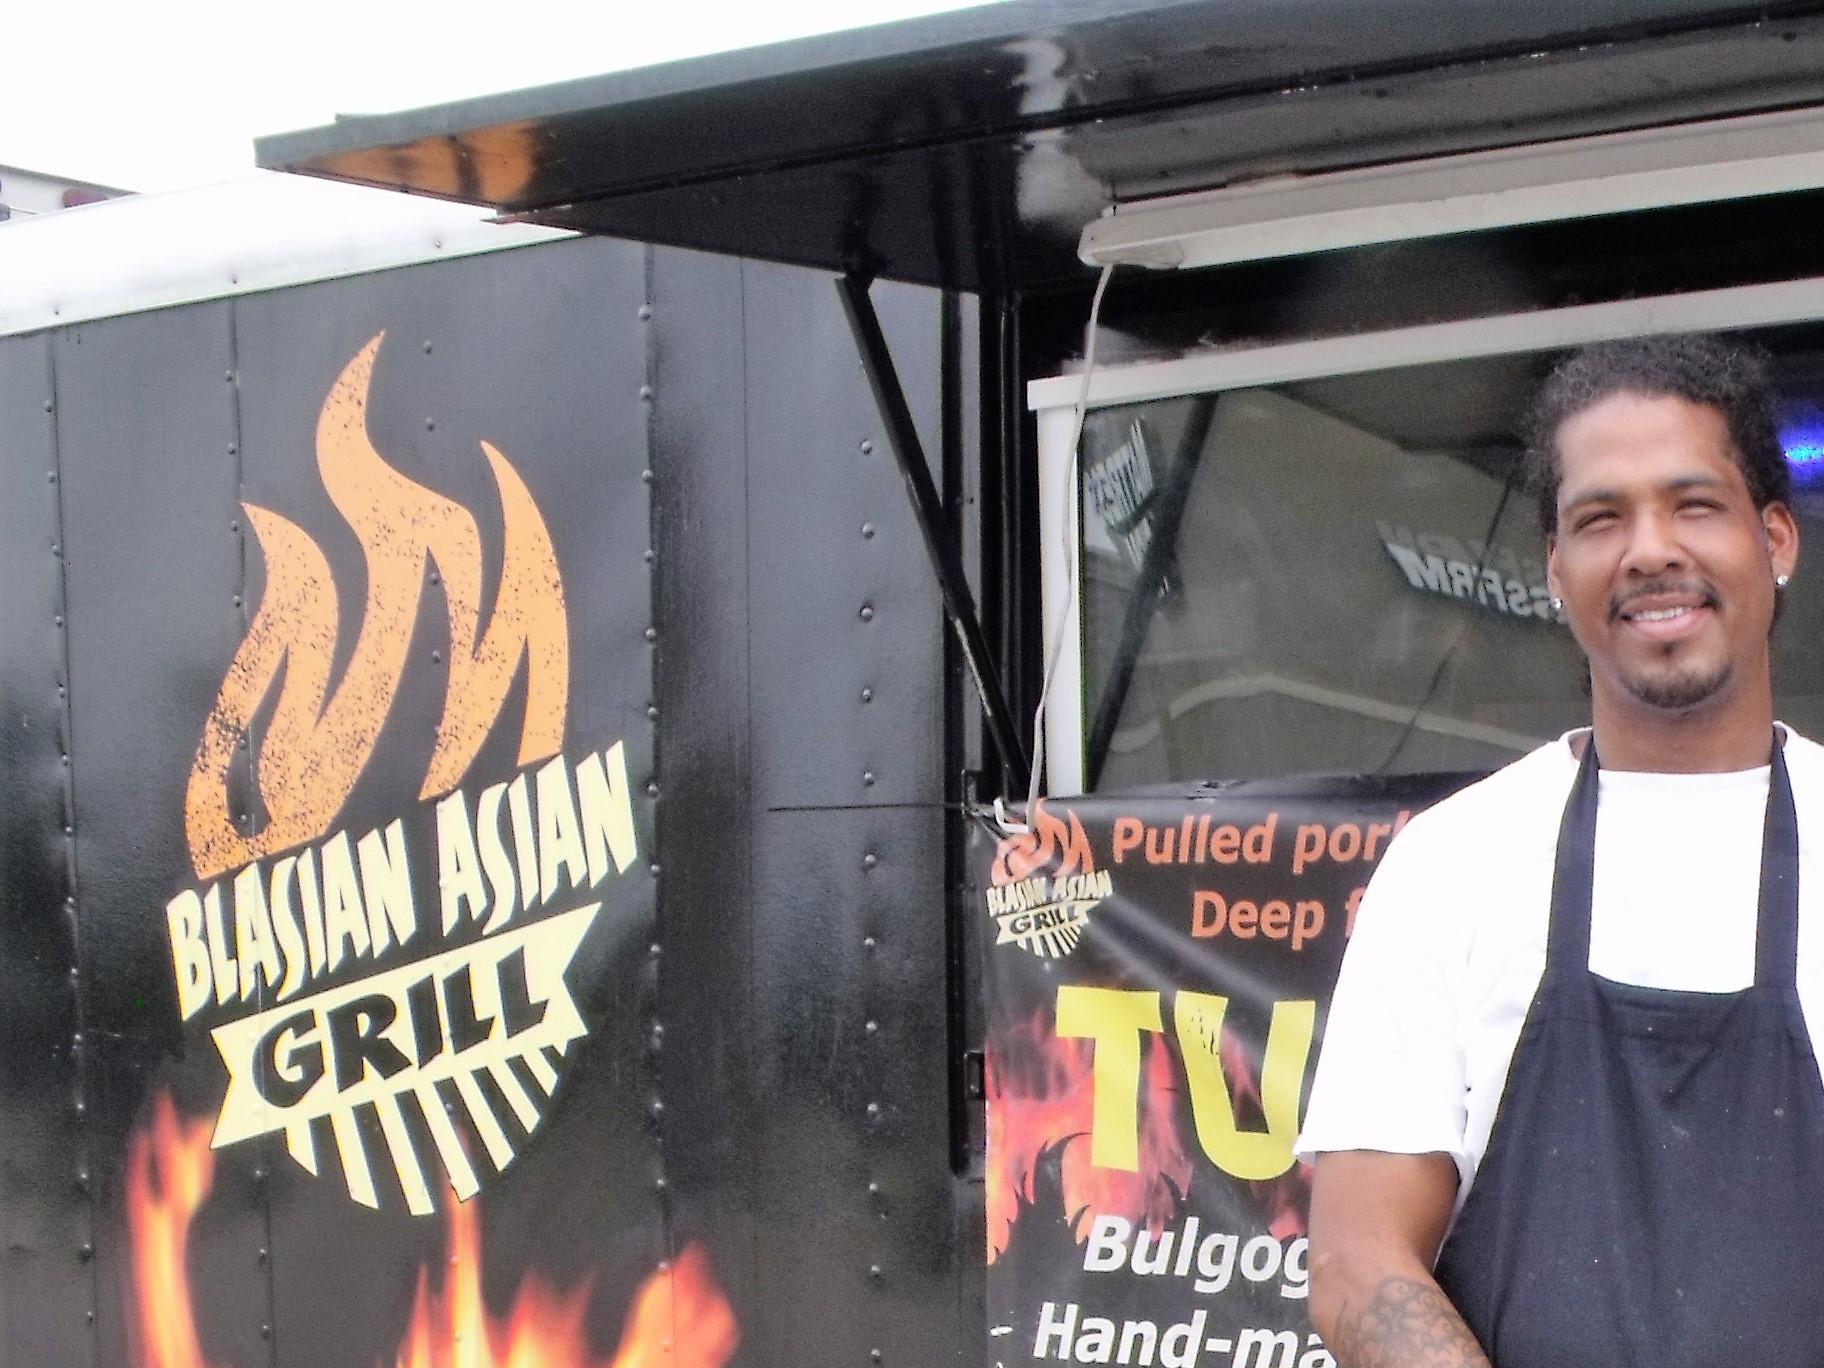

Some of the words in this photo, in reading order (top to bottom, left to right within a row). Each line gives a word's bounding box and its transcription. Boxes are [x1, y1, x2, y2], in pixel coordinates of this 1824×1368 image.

[1112, 814, 1278, 865] Pulled
[166, 818, 416, 1021] BLASIAN
[436, 740, 638, 937] ASIAN
[1010, 904, 1079, 935] GRILL
[1191, 890, 1326, 950] Deep
[252, 944, 551, 1109] GRILL
